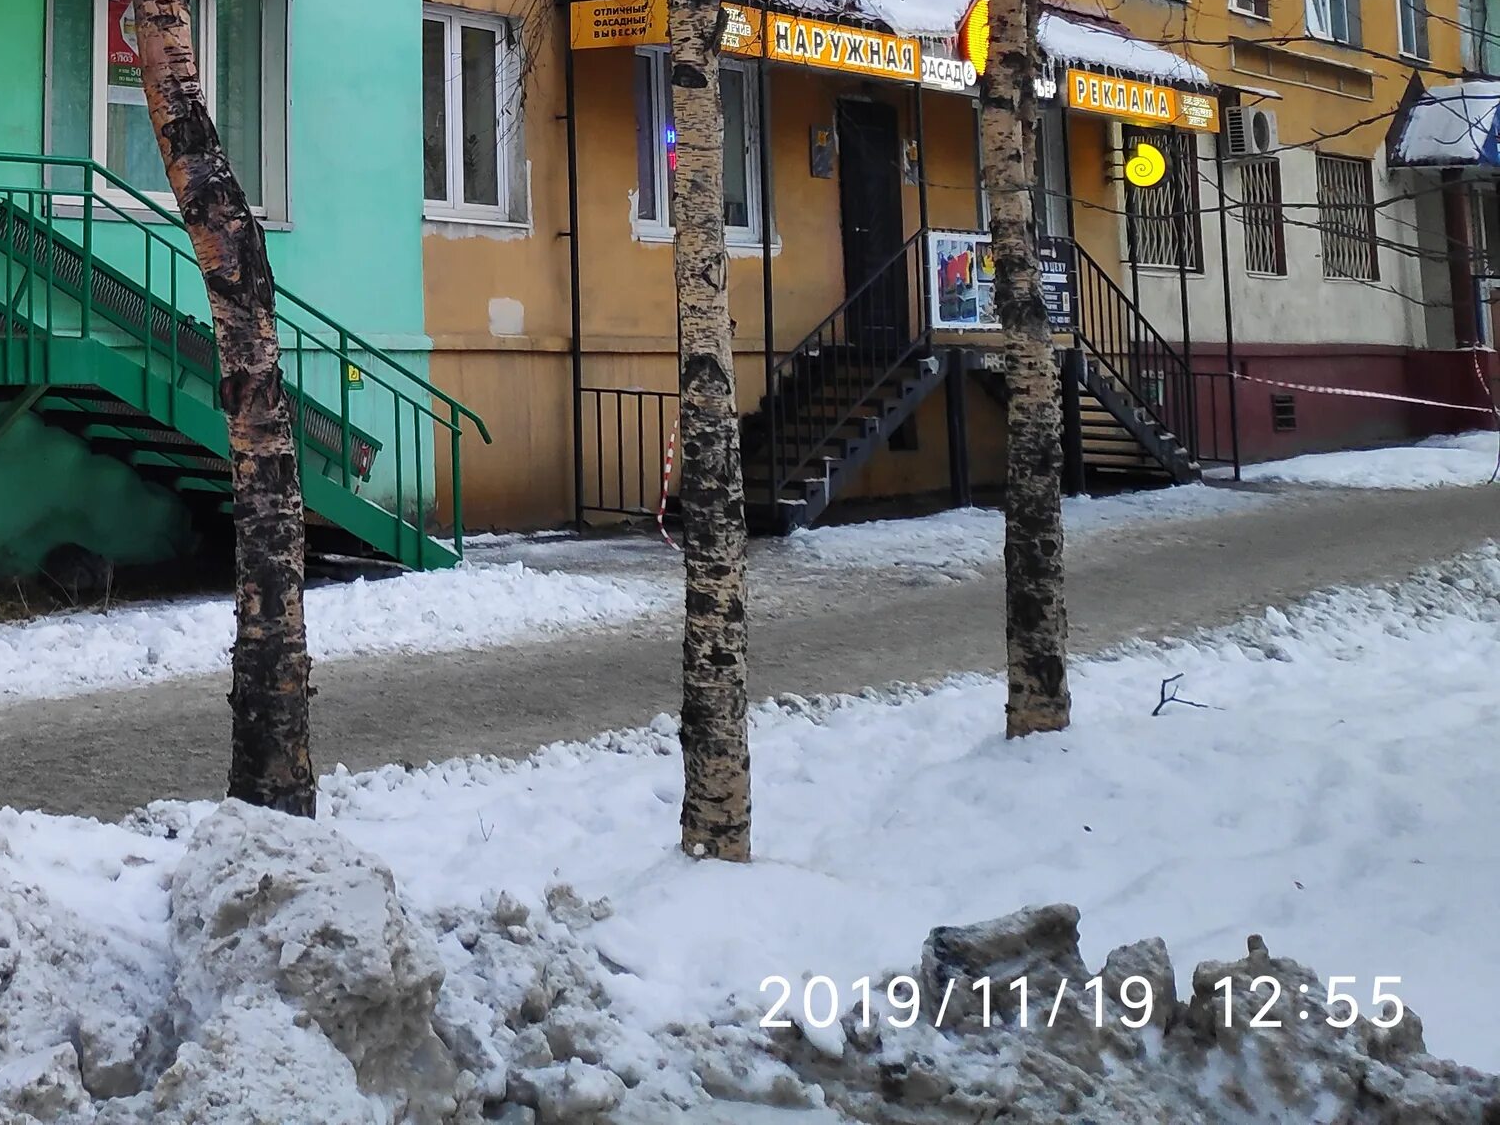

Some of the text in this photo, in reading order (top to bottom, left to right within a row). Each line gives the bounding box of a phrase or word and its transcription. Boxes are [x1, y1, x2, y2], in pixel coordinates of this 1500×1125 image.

[593, 4, 647, 17] ОТЛИЧНЫЕ
[593, 15, 646, 28] ФАСАДНЫЕ
[593, 27, 646, 39] ВЫВЕСКИ
[776, 22, 913, 72] НАРУЖНАЯ
[1077, 77, 1169, 117] РЕКЛАМА
